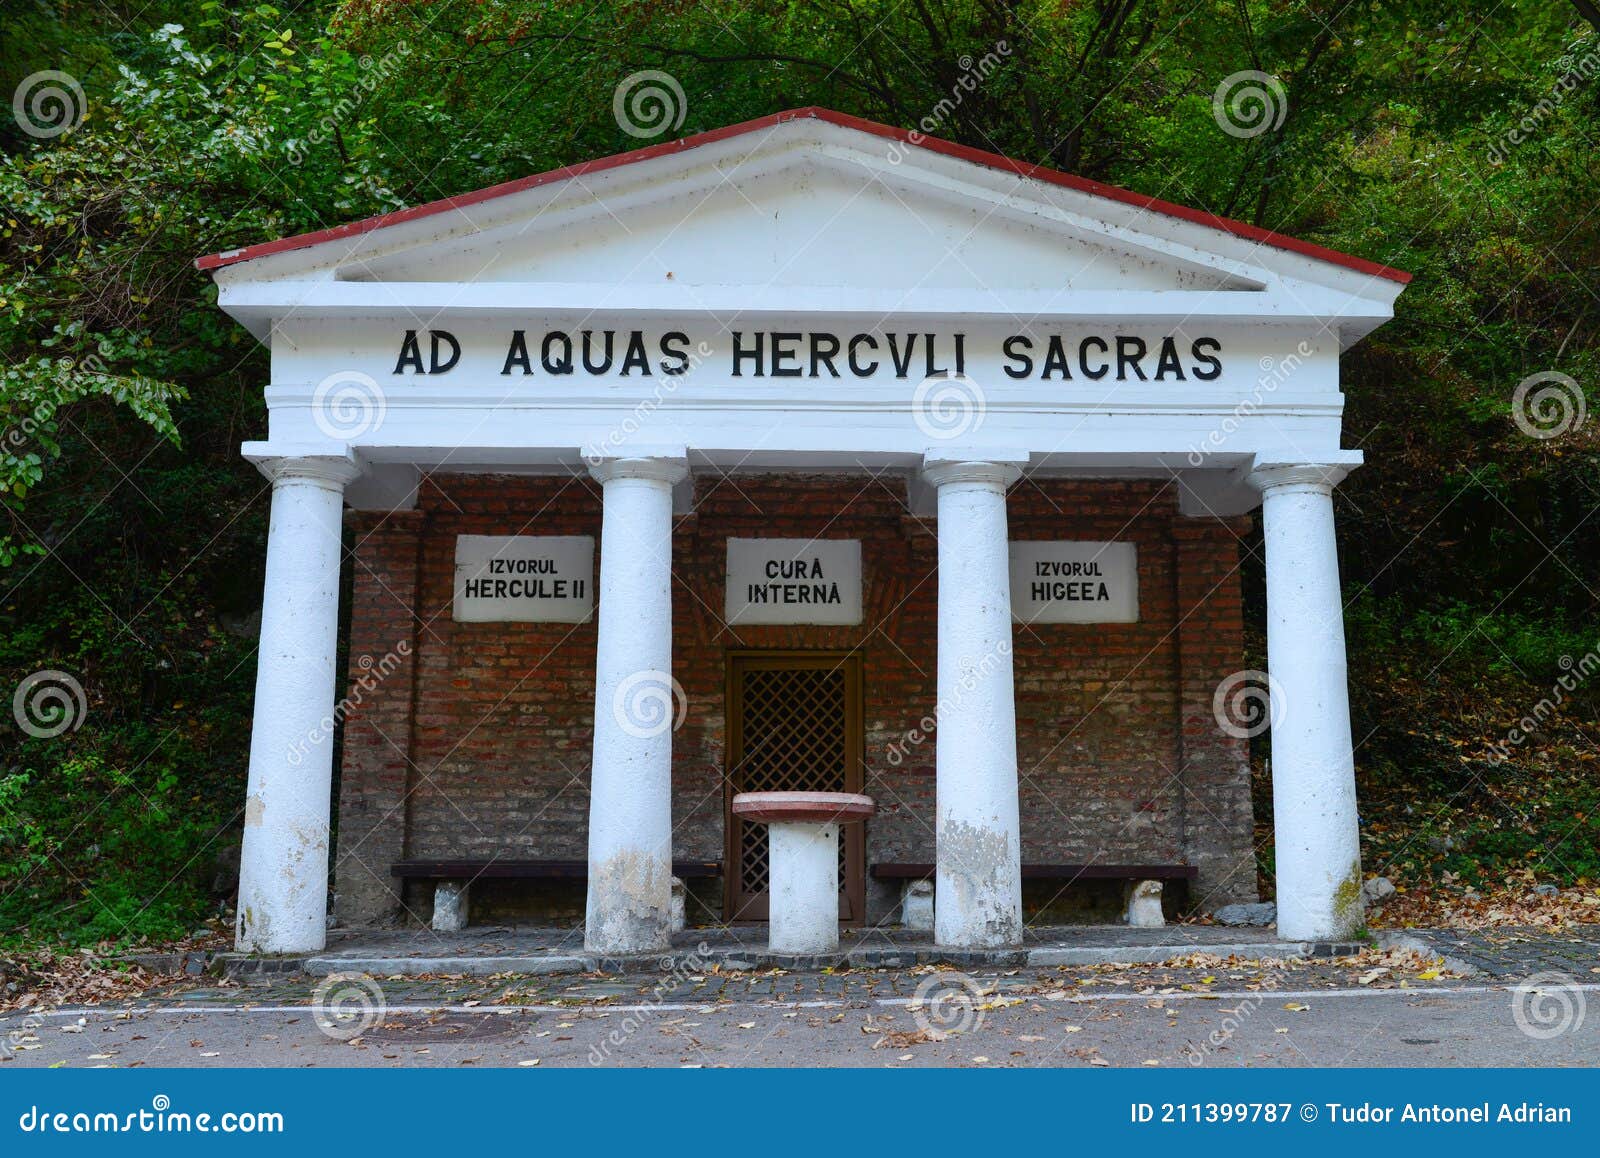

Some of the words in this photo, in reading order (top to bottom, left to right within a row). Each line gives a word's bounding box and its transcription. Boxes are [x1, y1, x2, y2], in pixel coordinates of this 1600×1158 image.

[394, 329, 462, 375] AD
[501, 330, 691, 376] AQUAS
[732, 332, 966, 378] HERCVLI
[1003, 335, 1223, 381] SACRAS
[488, 559, 559, 574] IZVORUL
[1035, 561, 1103, 577] IZVORUL
[465, 579, 567, 599] HERCULE
[573, 580, 585, 599] II
[1031, 582, 1110, 601] HIGEEA
